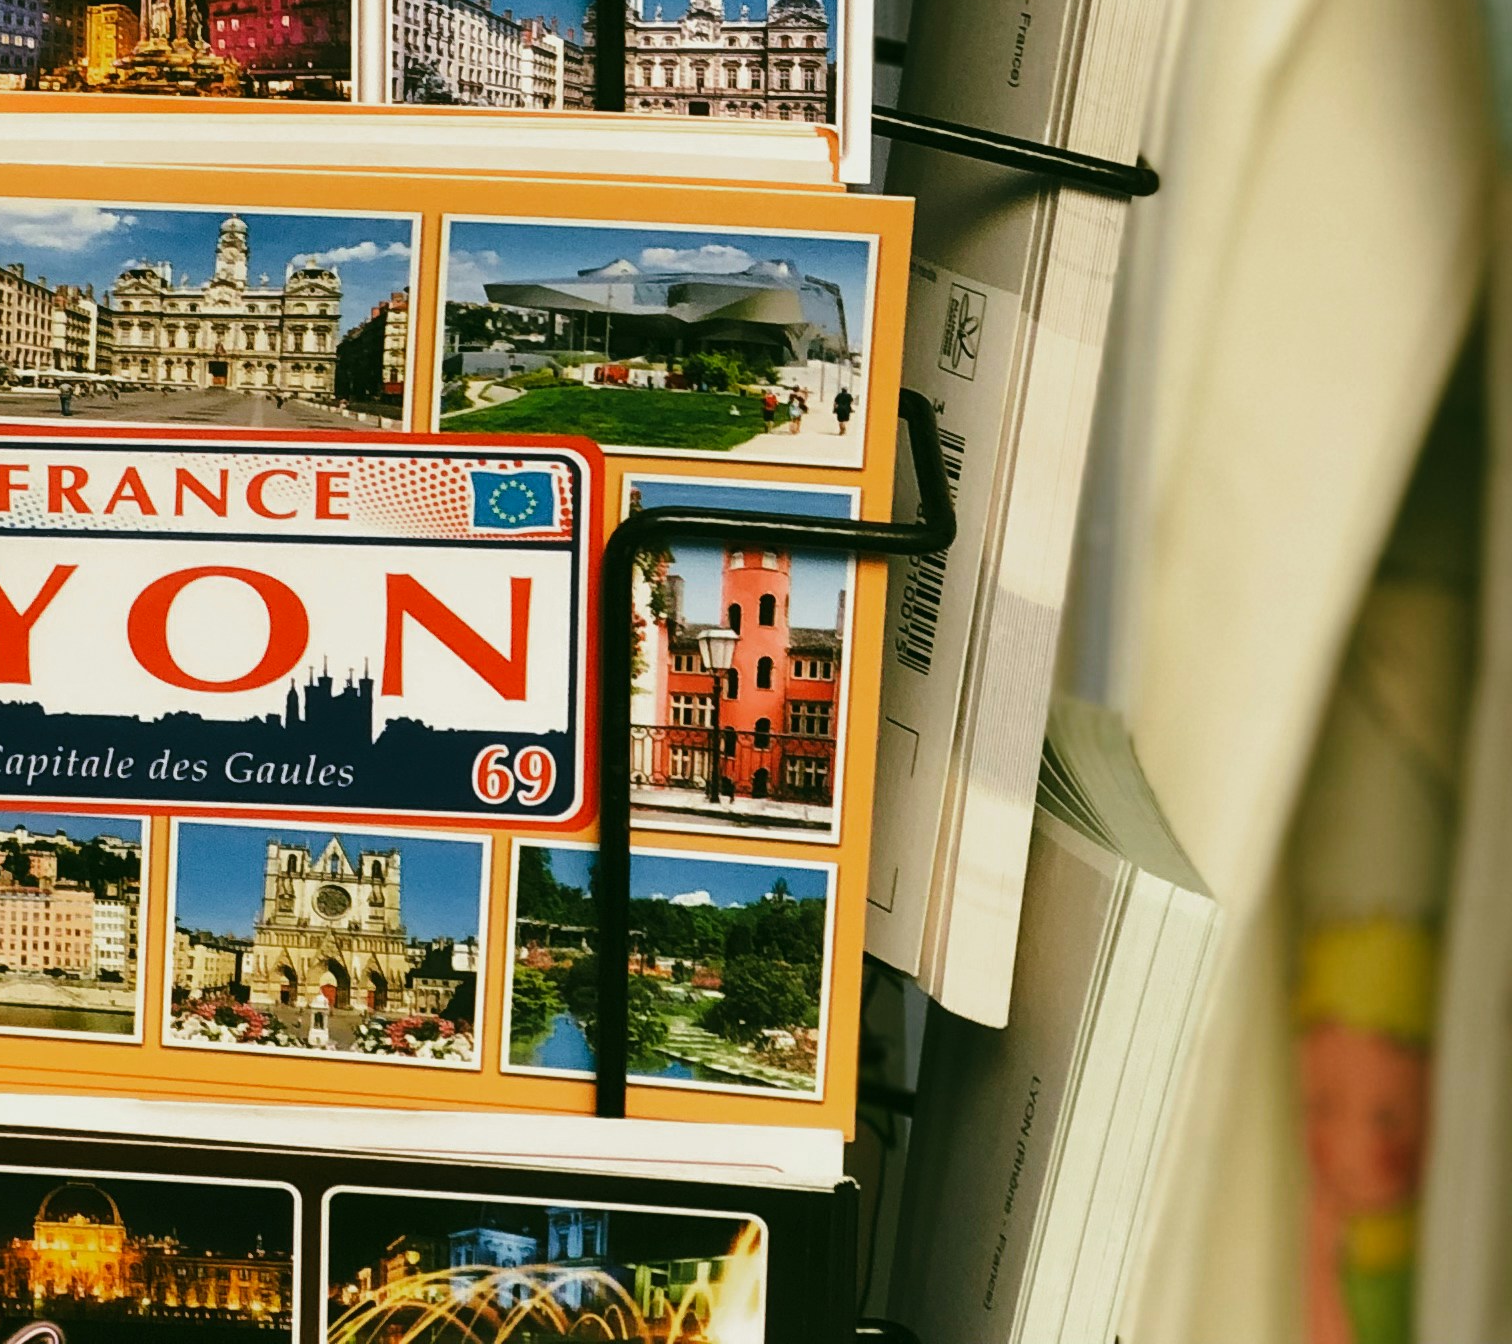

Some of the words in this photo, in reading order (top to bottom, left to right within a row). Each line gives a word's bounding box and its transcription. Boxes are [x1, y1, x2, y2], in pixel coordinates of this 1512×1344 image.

[1006, 12, 1032, 88] France)
[150, 747, 209, 782] des
[225, 751, 355, 788] Gaules
[471, 743, 558, 806] 69
[1020, 1074, 1042, 1138] LYON
